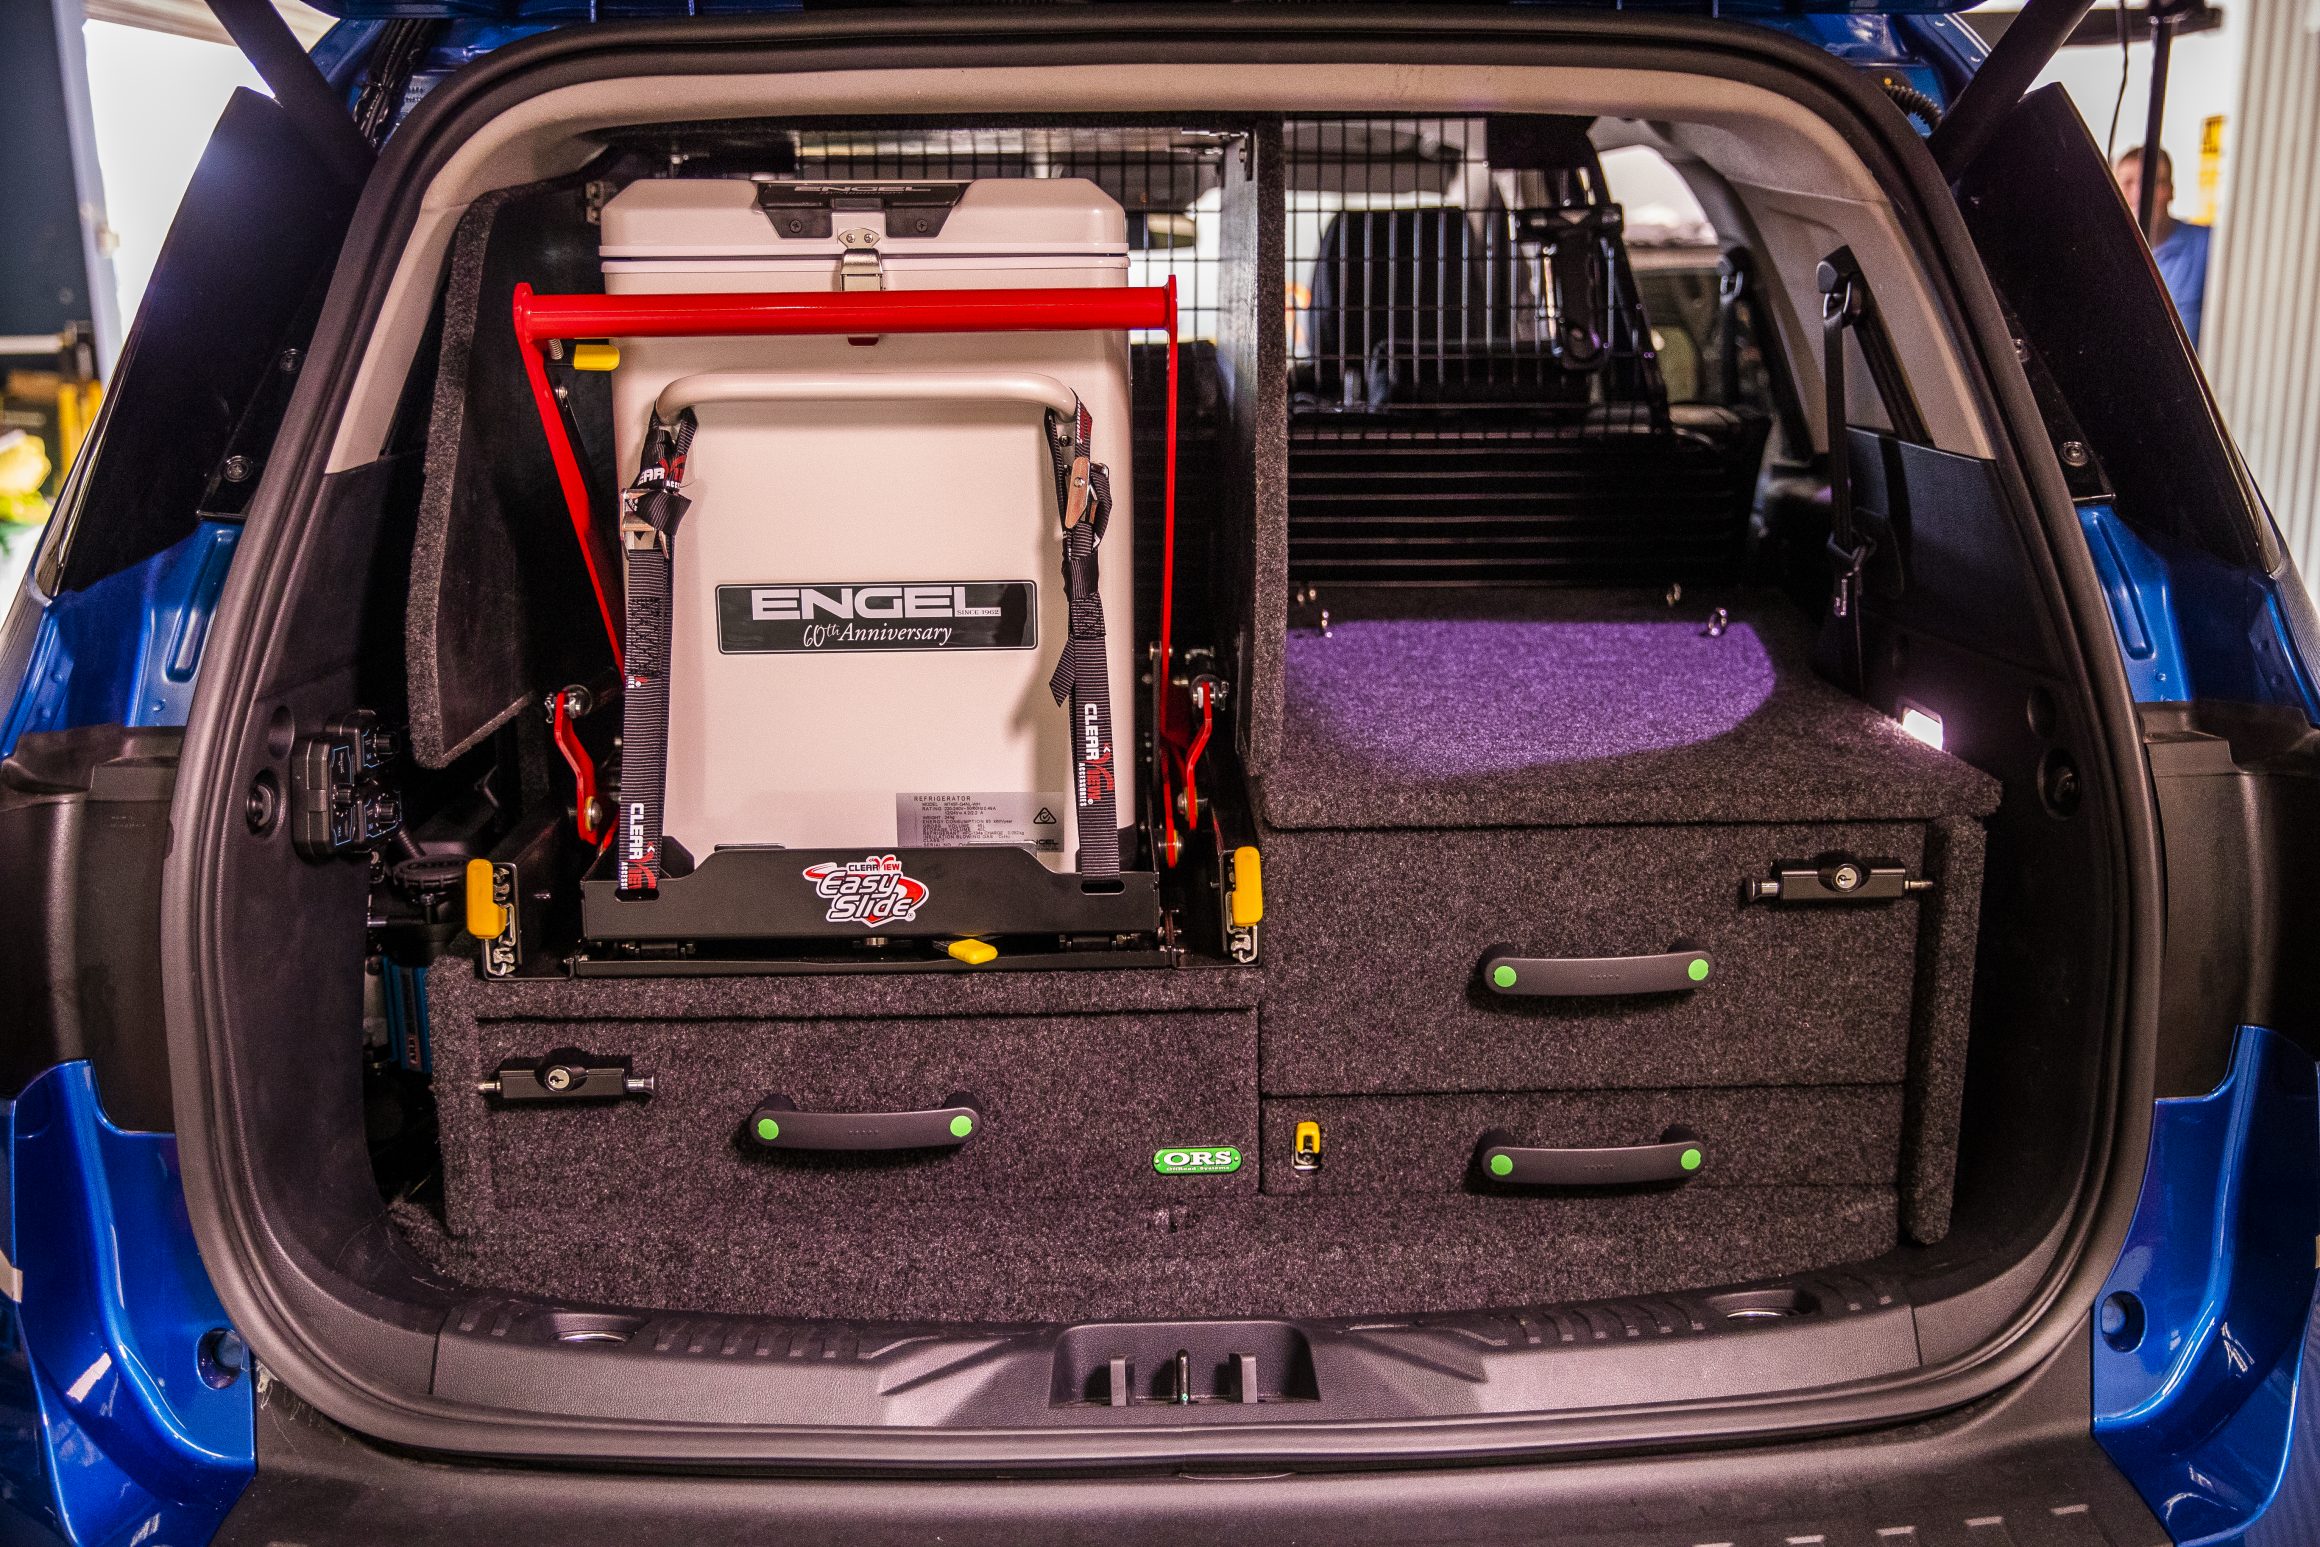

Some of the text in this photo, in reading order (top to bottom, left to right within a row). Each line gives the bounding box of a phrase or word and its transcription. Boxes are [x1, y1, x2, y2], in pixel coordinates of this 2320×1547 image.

[752, 586, 1001, 620] ENGEL
[803, 622, 952, 647] 60th Anniversary
[1078, 762, 1087, 807] ACCESSORIES
[820, 870, 901, 898] Easy
[829, 892, 914, 919] Slide
[1163, 1150, 1232, 1166] ORS
